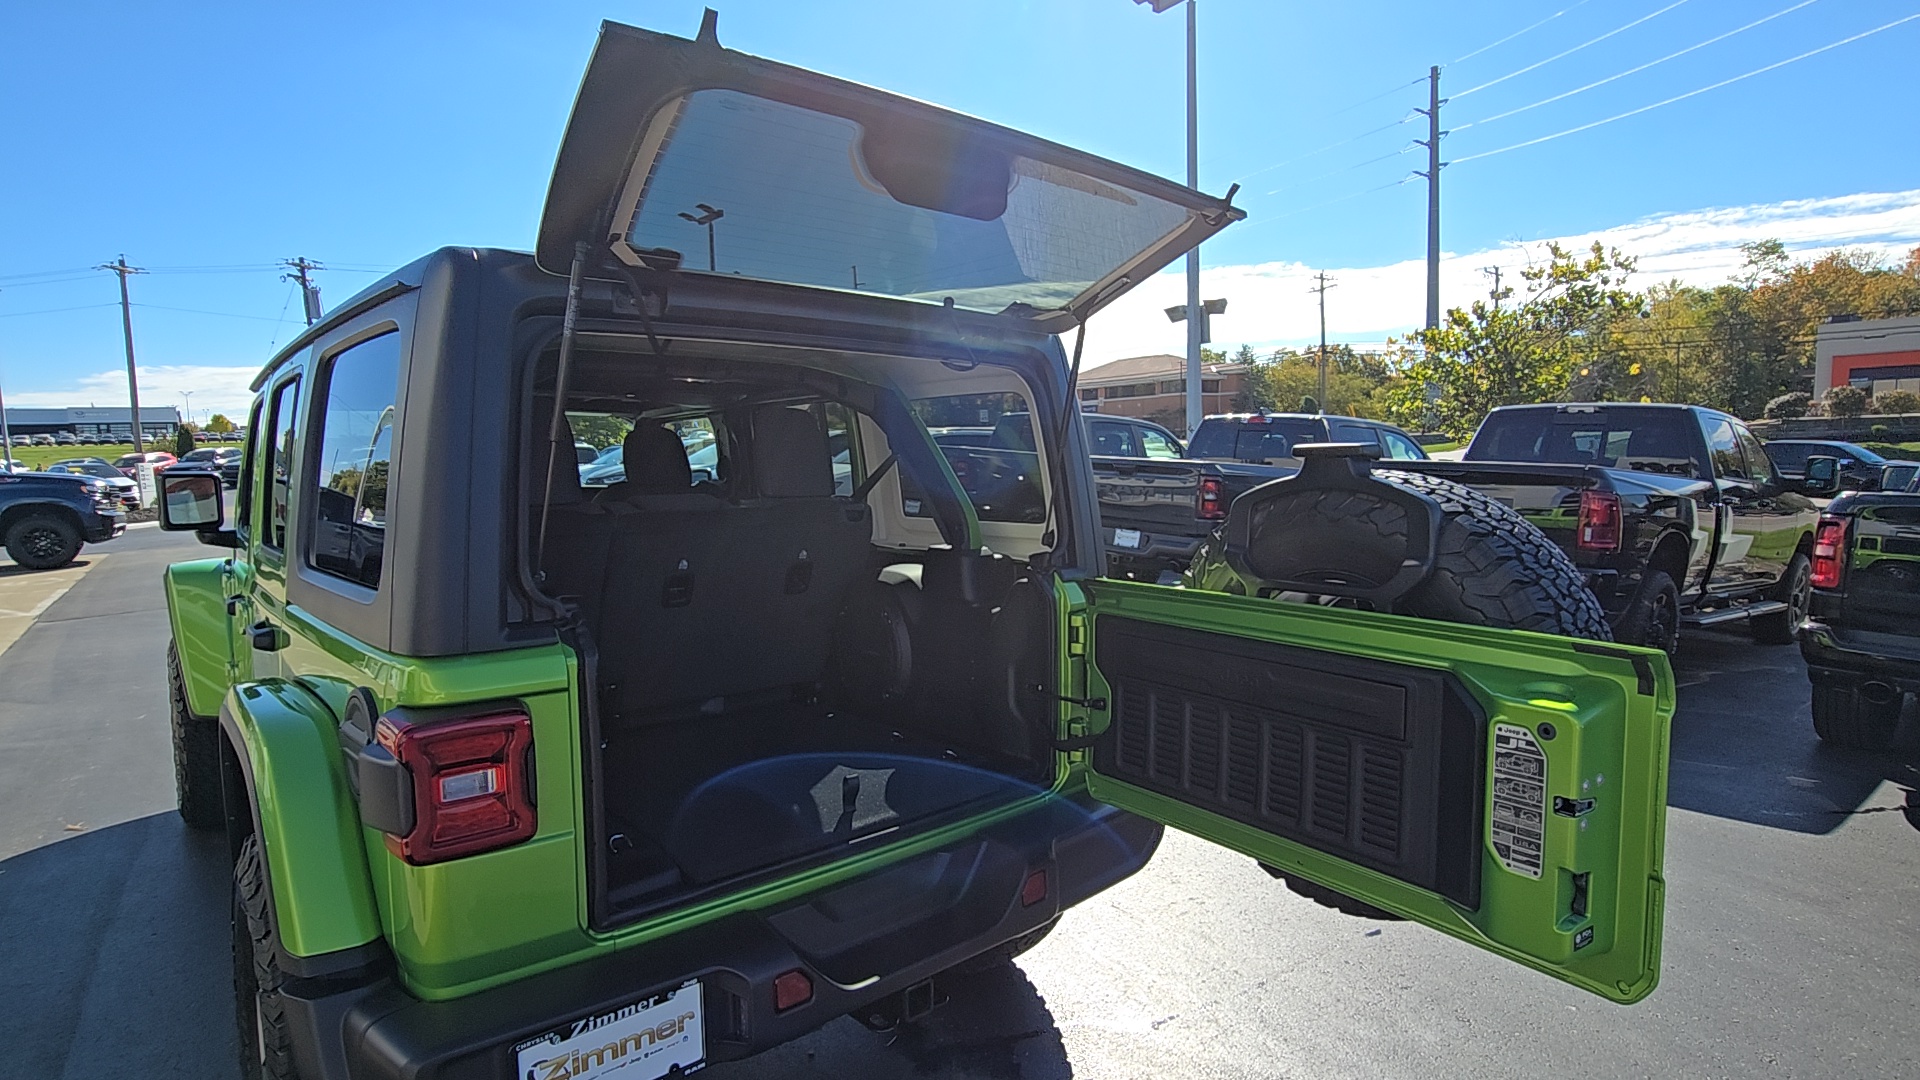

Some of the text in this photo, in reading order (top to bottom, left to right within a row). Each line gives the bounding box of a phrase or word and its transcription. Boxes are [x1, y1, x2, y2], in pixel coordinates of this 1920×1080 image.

[1503, 727, 1521, 736] Jeep
[570, 994, 660, 1040] Zimmer
[515, 1032, 555, 1052] CHRYSLER
[539, 1010, 696, 1080] Zimmer
